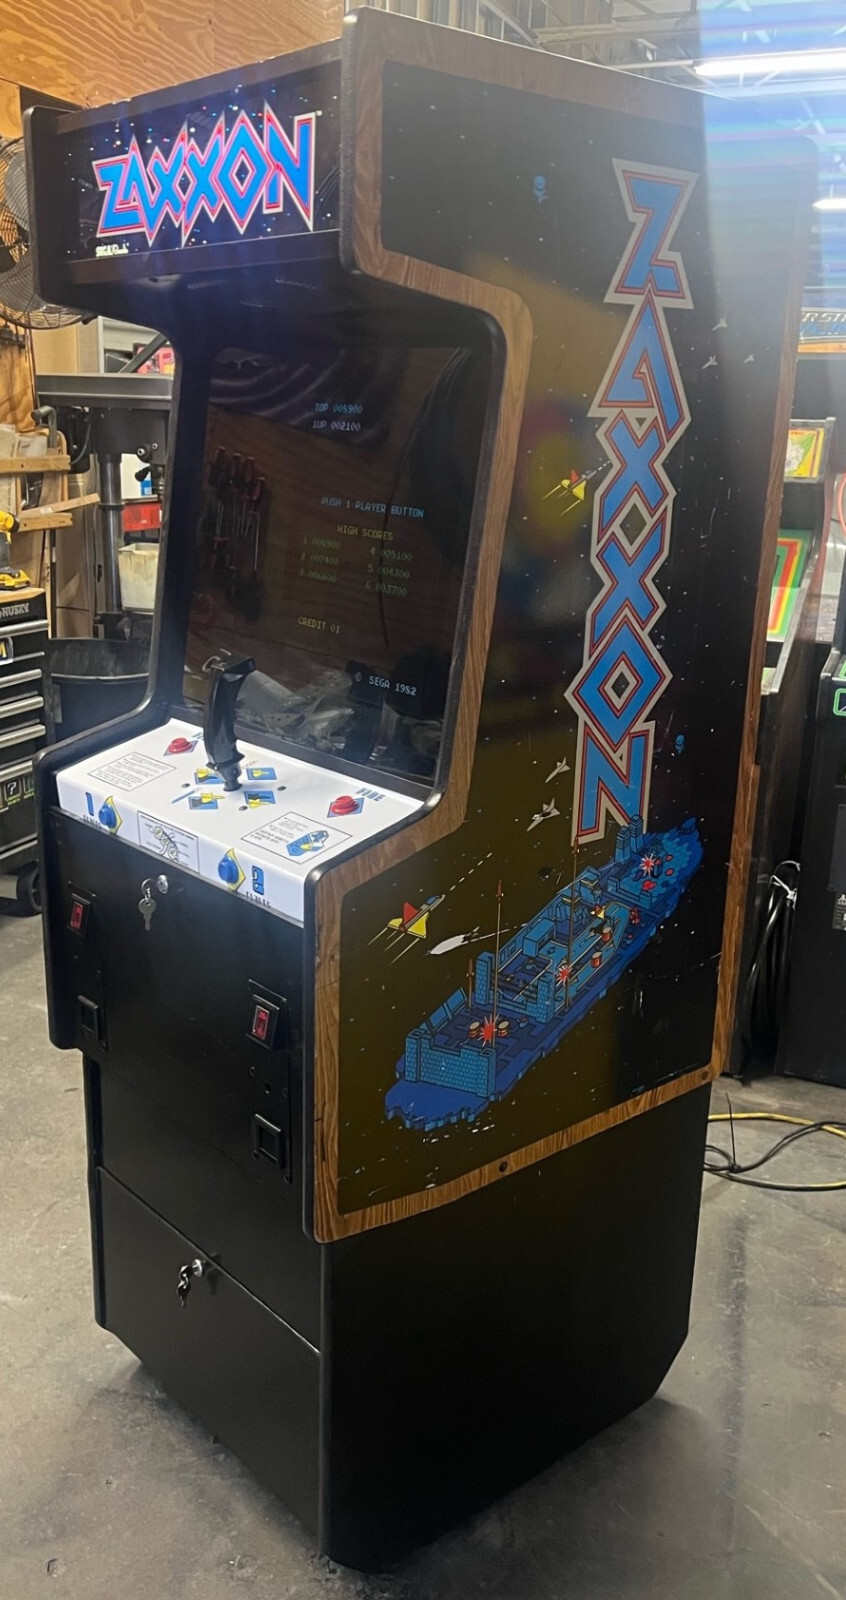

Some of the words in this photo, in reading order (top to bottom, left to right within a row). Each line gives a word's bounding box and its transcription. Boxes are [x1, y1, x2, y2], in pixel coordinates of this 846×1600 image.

[92, 100, 315, 248] ZAXXON
[312, 420, 327, 429] 1UP
[330, 420, 361, 432] 002100
[321, 497, 342, 506] PUSH
[355, 502, 386, 513] PLAYER
[391, 505, 424, 518] BUTTON
[564, 158, 699, 847] ZAXXON
[337, 525, 358, 536] HIGH
[362, 529, 393, 541] SCORES
[369, 547, 376, 555] 4
[1, 603, 30, 618] HUSKY
[298, 616, 326, 631] CREDIT
[330, 624, 341, 634] 01
[368, 676, 390, 689] SEGA
[355, 787, 386, 802] FIRE
[252, 865, 265, 896] 2
